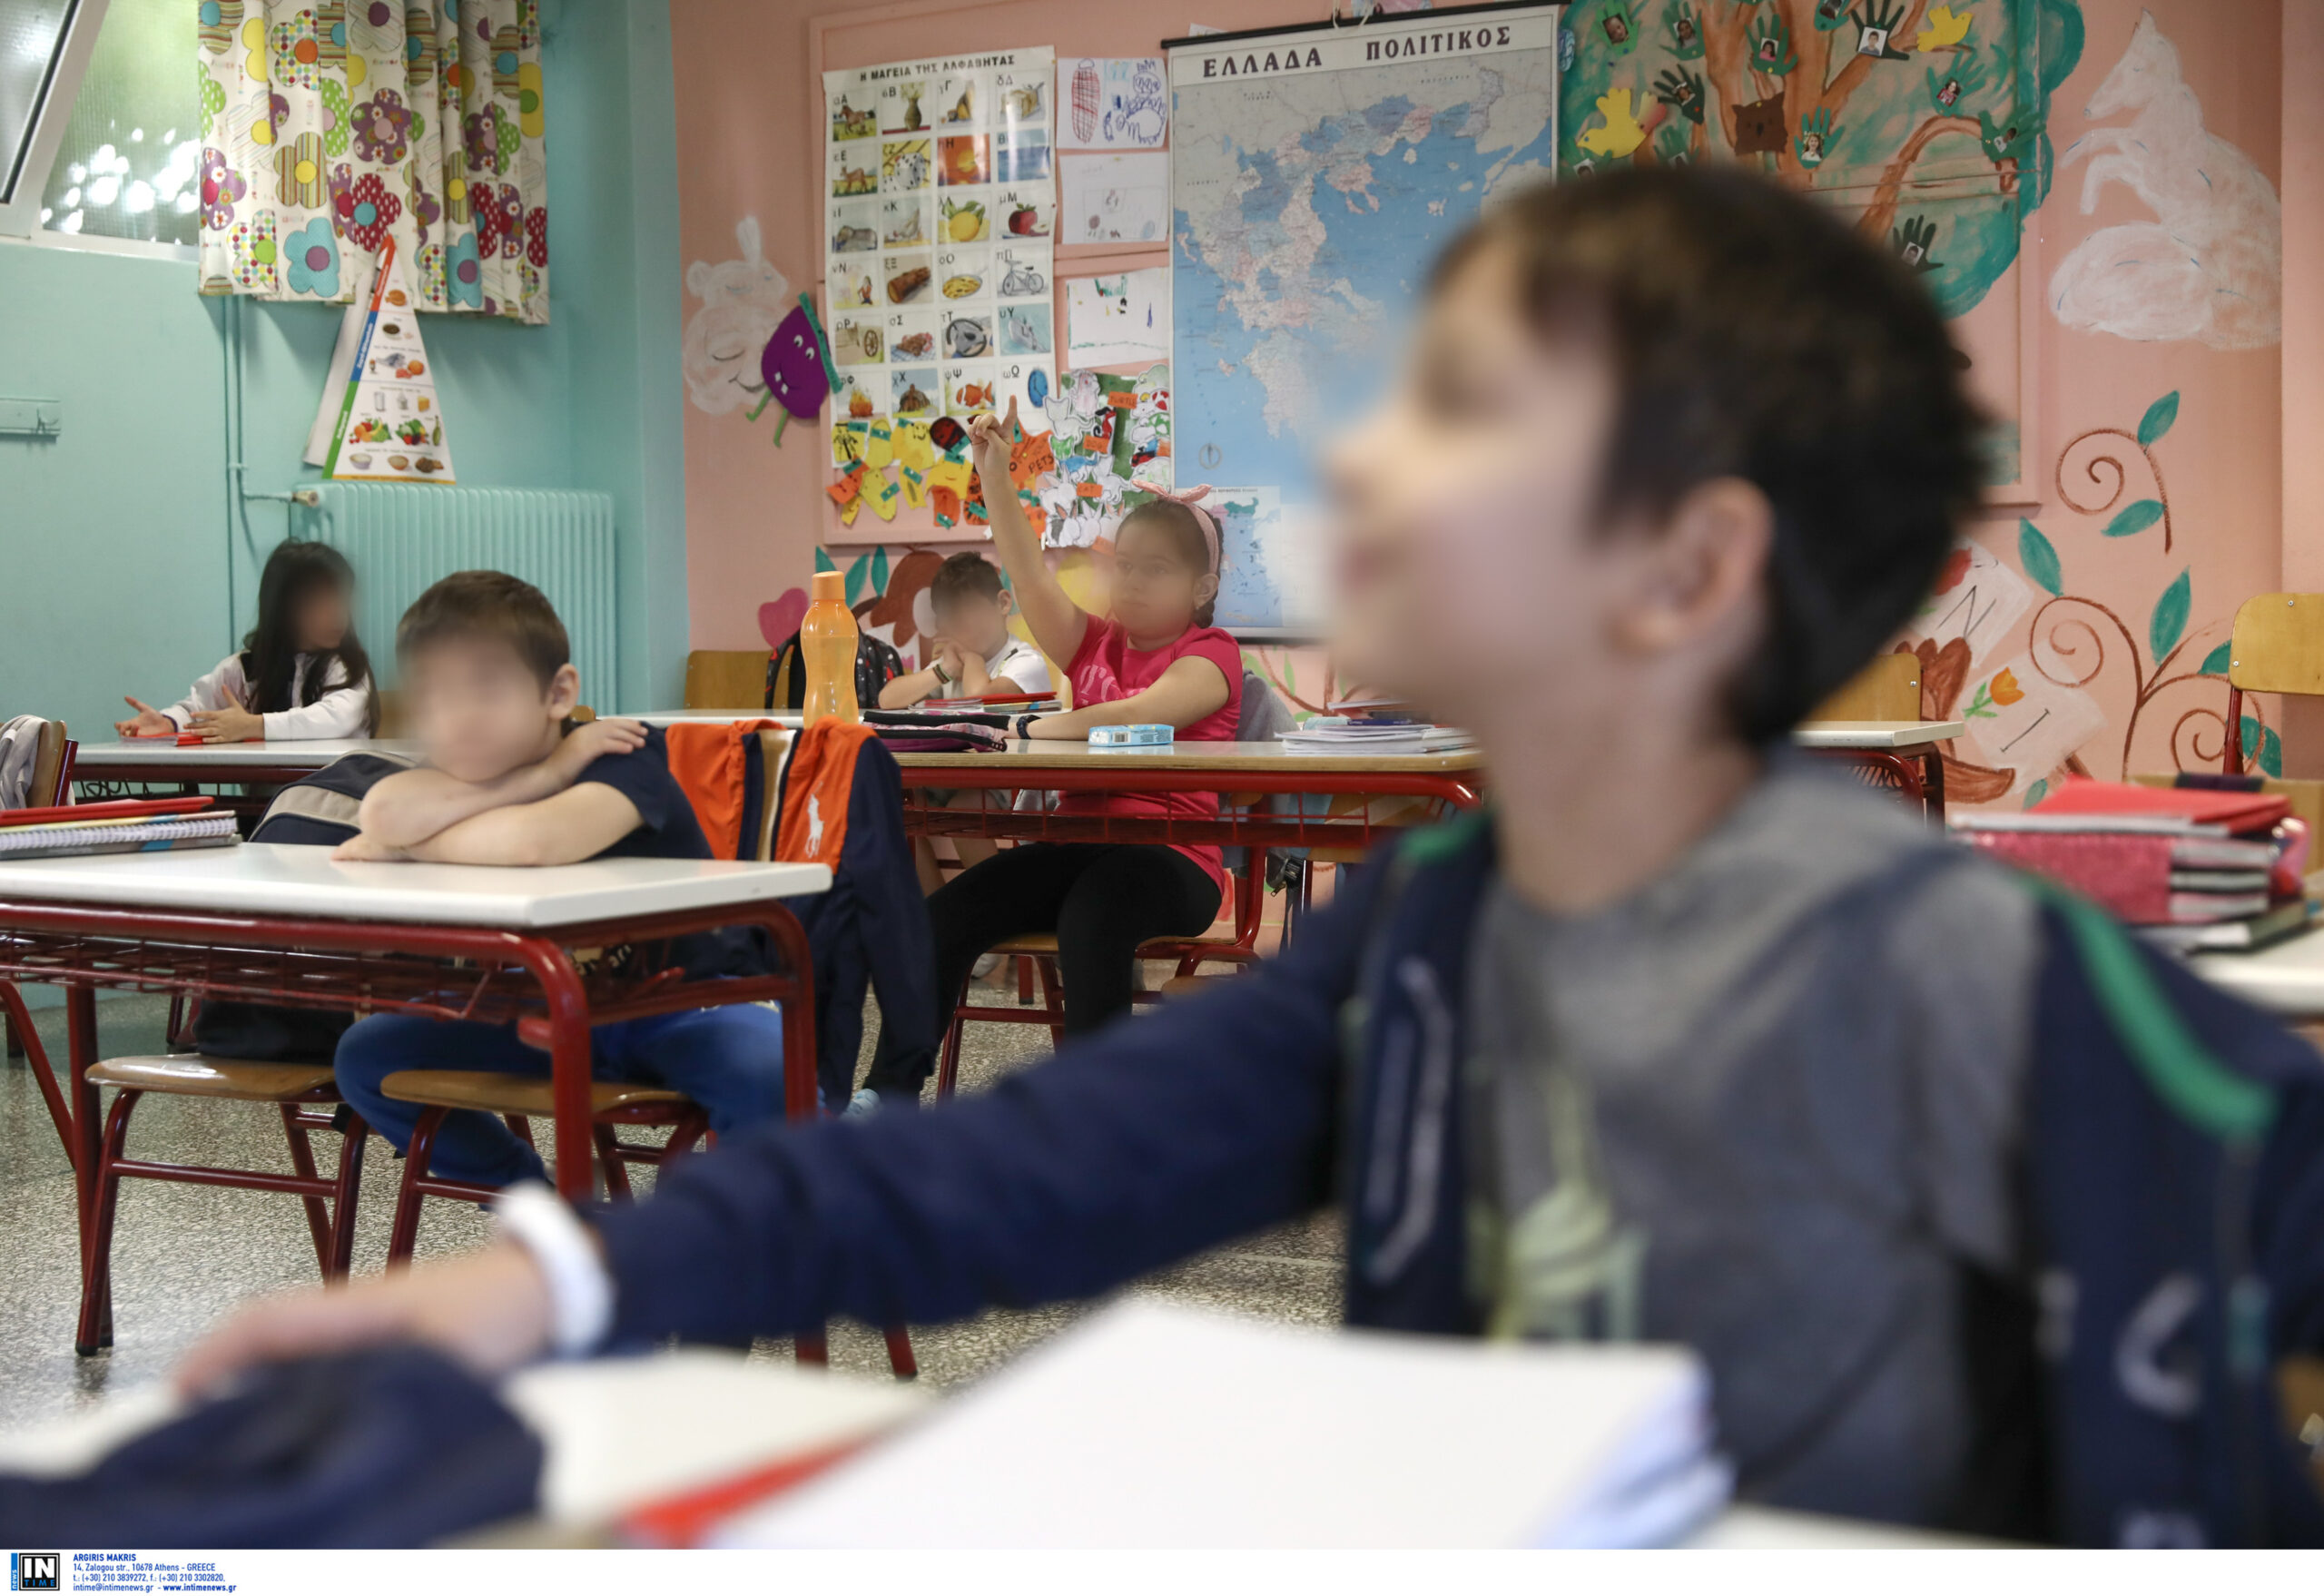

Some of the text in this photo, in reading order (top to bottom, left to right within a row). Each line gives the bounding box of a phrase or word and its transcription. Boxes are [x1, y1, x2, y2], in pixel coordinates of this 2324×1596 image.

[1203, 25, 1511, 78] ΕΛΛΑΔΑ ΠΟΛΙΤΙΚΟΣ
[860, 54, 1015, 82] Η ΜΑΓΕΙΑ ΤΗΣ ΑΛΦΑΒΗΤΑΣ
[1029, 454, 1054, 474] PETS
